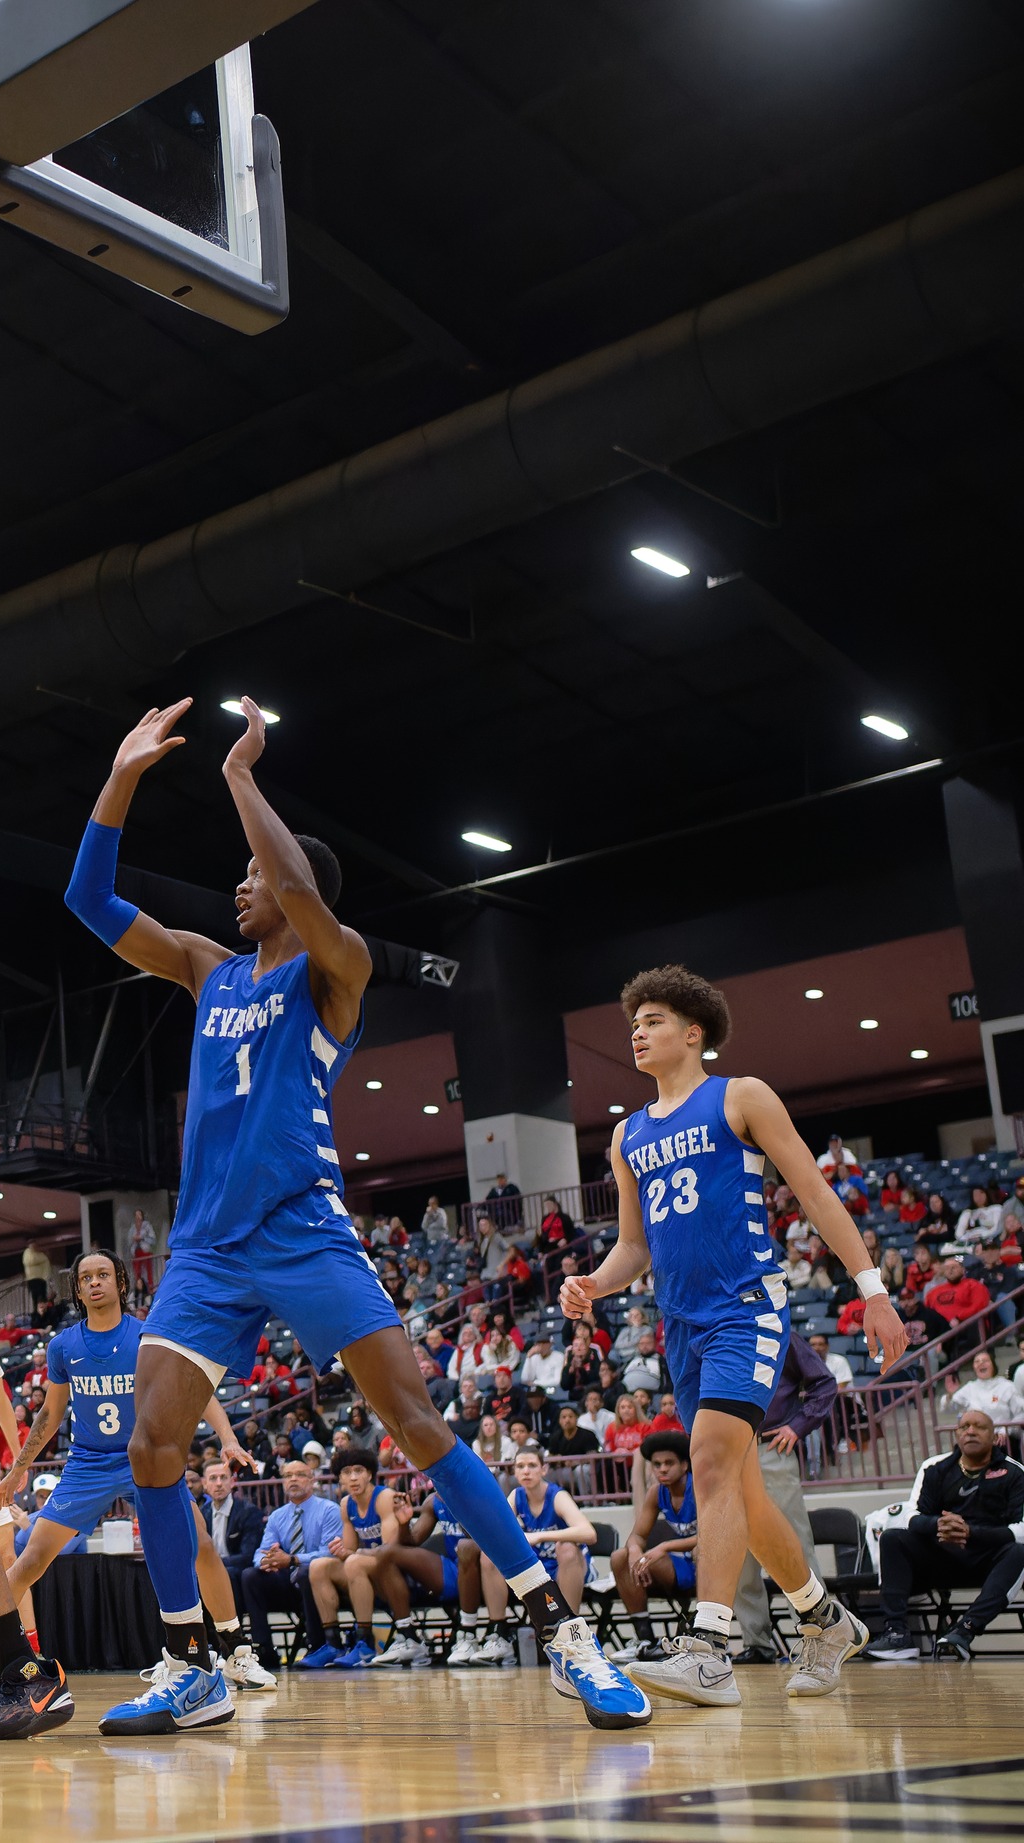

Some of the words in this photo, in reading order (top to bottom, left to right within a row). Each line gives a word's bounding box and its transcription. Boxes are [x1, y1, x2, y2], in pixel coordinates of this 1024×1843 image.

[235, 1043, 251, 1096] 1
[628, 1124, 716, 1179] EVANGEL
[647, 1167, 700, 1225] 23
[72, 1374, 136, 1396] EVANGE
[97, 1402, 121, 1435] 3
